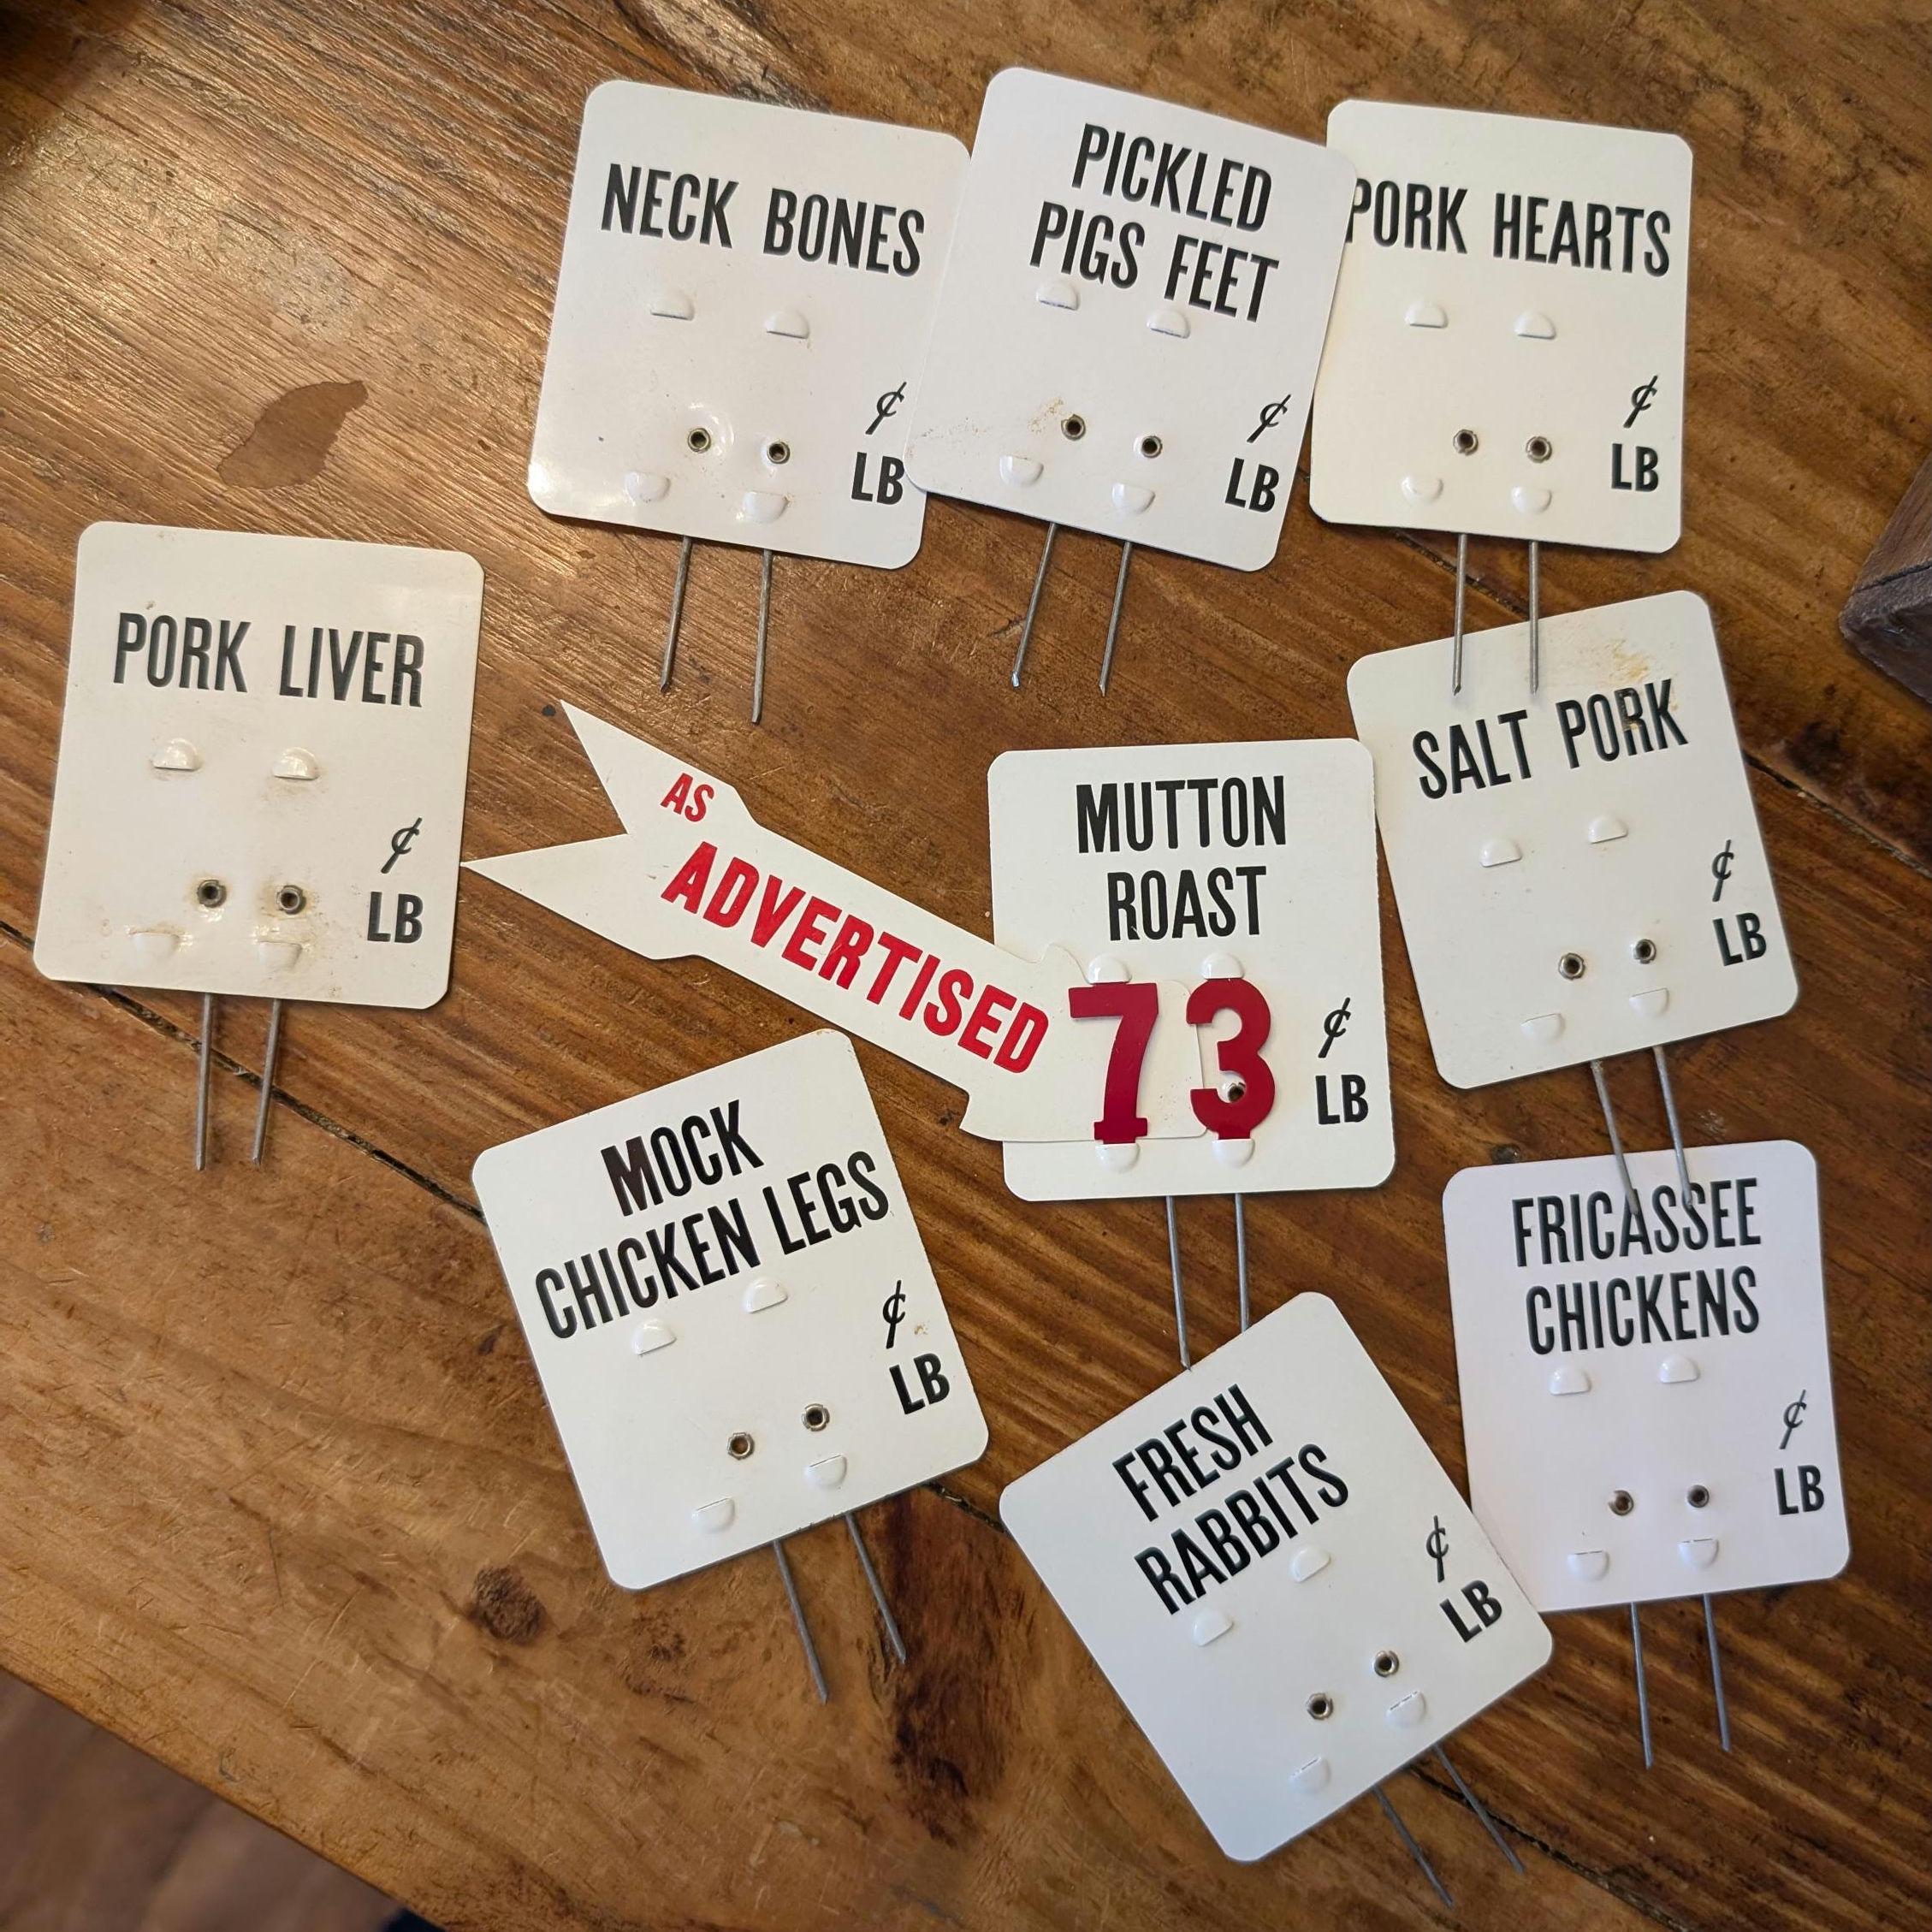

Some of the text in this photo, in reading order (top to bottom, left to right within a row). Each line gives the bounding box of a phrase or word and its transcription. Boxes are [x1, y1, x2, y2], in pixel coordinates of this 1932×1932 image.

[601, 163, 925, 276] NECK BONES
[1070, 123, 1271, 232] PICKLED
[1030, 201, 1280, 322] PIGS FEET
[1345, 177, 1671, 276] PORK HEARTS
[850, 451, 905, 505] LB
[1224, 457, 1279, 513] LB
[1611, 443, 1659, 492] LB
[113, 612, 423, 708] PORK LIVER
[1413, 679, 1690, 800] SALT PORK
[661, 773, 714, 822] AS
[1076, 775, 1286, 854] MUTTON
[367, 891, 423, 944] LB
[1107, 865, 1267, 941] ROAST
[1712, 912, 1767, 967] LB
[661, 841, 1048, 1074] ADVERTISED
[1069, 978, 1276, 1144] 73
[1315, 1074, 1369, 1125] LB
[601, 1099, 764, 1218] MOCK
[536, 1152, 889, 1339] CHICKEN LEGS
[1512, 1177, 1761, 1267] FRICASSEE
[1526, 1265, 1759, 1355] CHICKENS
[889, 1353, 950, 1415] LB
[1111, 1384, 1273, 1522] FRESH
[1774, 1465, 1824, 1515] LB
[1134, 1443, 1348, 1615] RABBITS
[1439, 1579, 1502, 1643] LB
